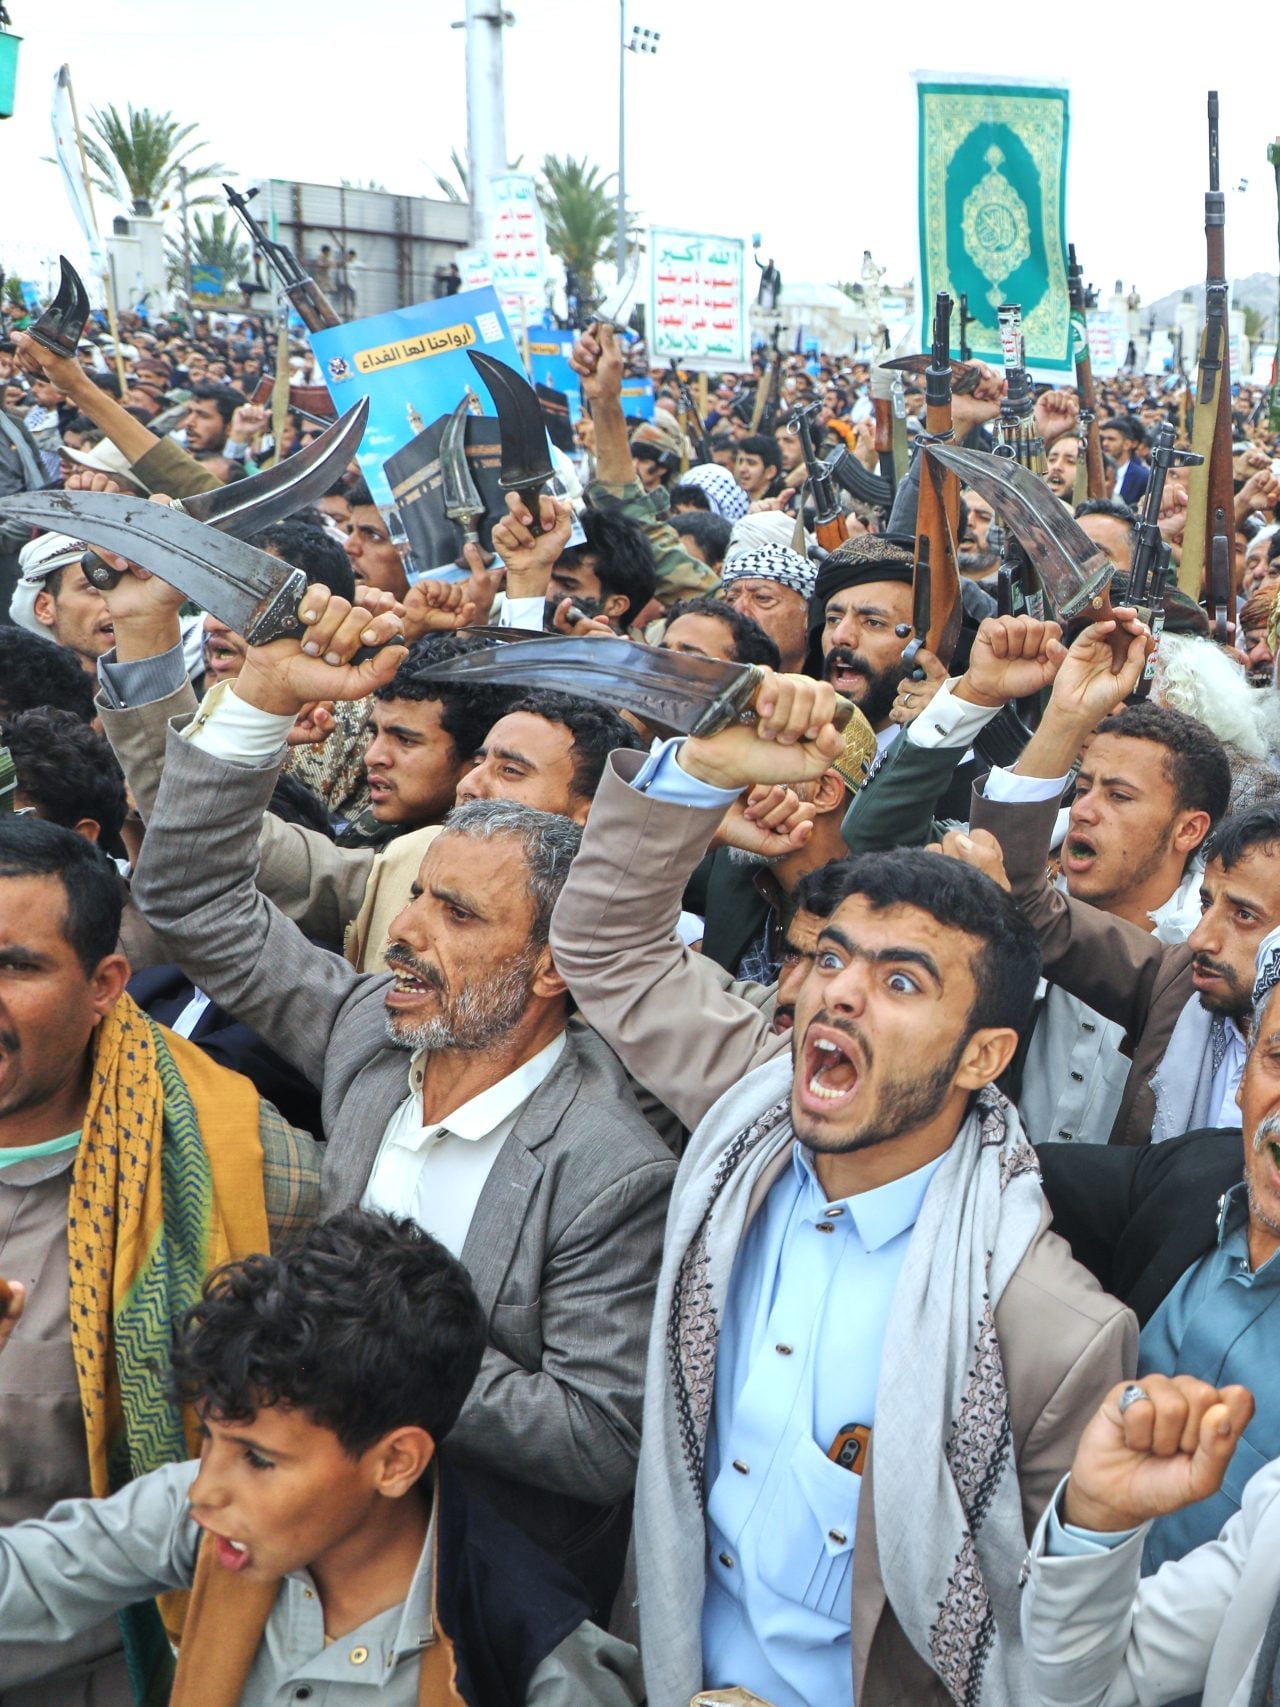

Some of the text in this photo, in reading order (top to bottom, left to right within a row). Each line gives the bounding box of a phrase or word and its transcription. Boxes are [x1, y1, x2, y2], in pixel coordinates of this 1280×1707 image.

[404, 336, 426, 357] لها
[429, 325, 471, 350] أرواحنا
[361, 345, 401, 370] الفداء
